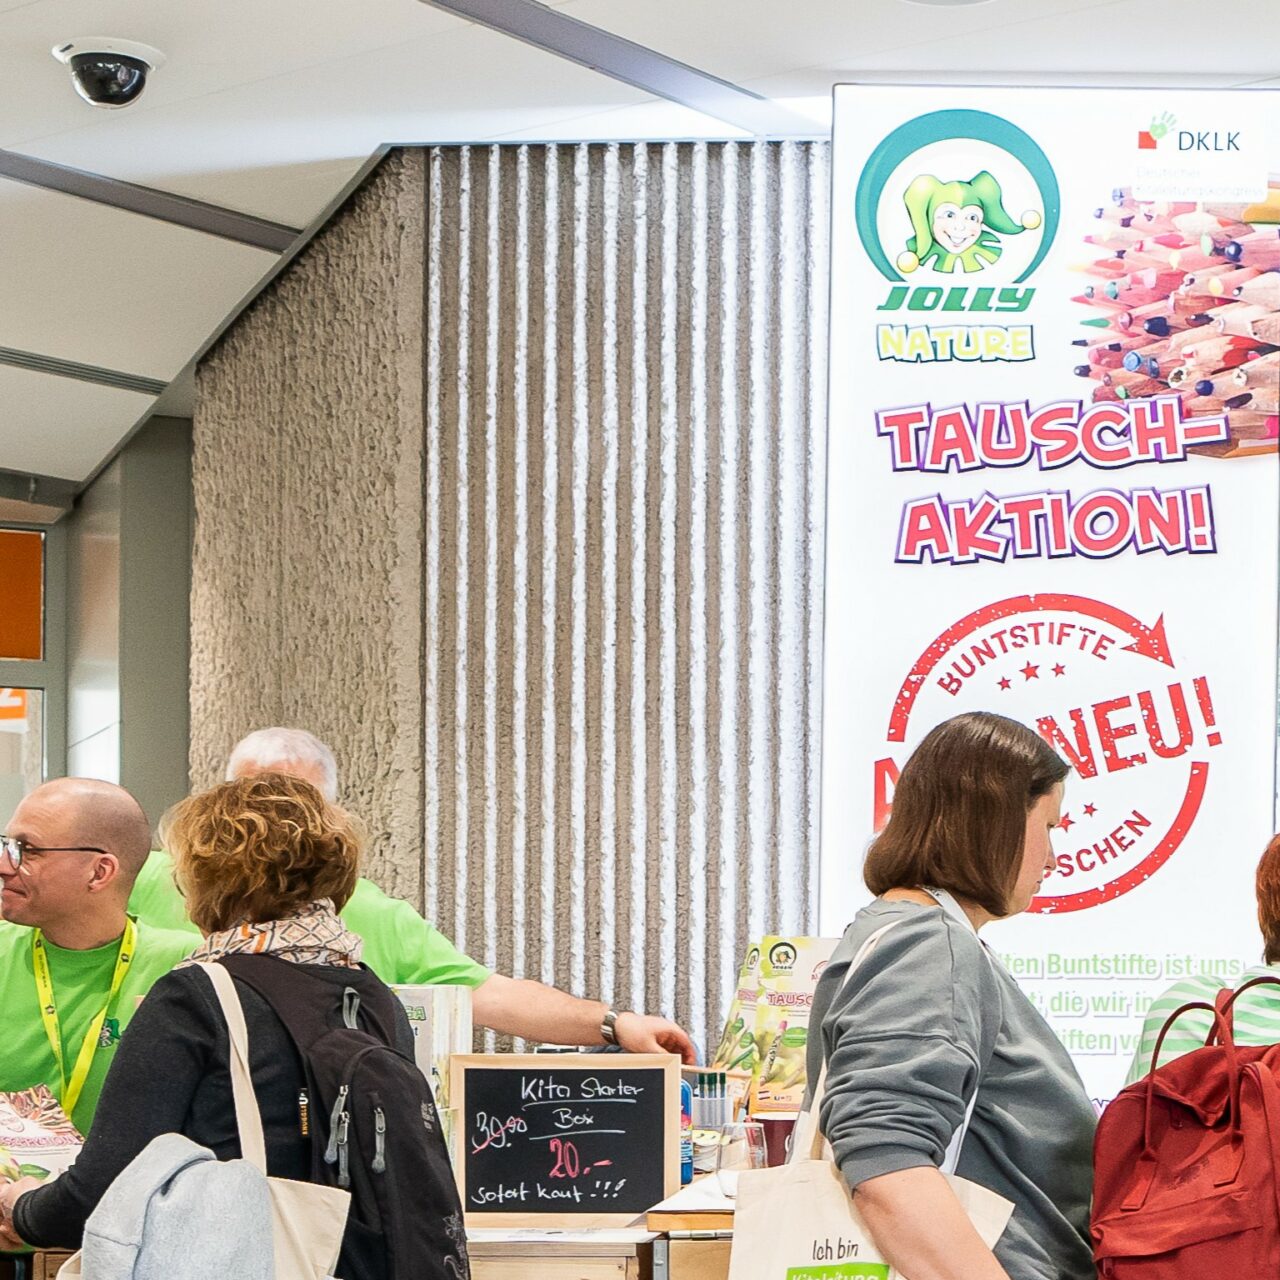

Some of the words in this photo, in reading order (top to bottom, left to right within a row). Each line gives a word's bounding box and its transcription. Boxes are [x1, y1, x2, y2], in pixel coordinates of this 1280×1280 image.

[1179, 131, 1240, 151] DKLK
[876, 286, 1036, 311] JOLLY
[877, 324, 1035, 363] NATURE
[876, 395, 1231, 474] TAUSCH-
[896, 483, 1217, 565] AKTION!
[936, 621, 1116, 697] BUNTSTIFTE
[1032, 675, 1222, 780] NEU!
[1043, 809, 1153, 880] SCHEN
[1001, 953, 1040, 975] lten
[1047, 953, 1159, 976] Buntstifte
[1165, 953, 1192, 976] ist
[1200, 959, 1240, 976] uns
[1051, 991, 1084, 1013] die
[1091, 991, 1128, 1013] wir
[521, 1076, 571, 1101] Kita
[580, 1077, 644, 1099] Starter
[552, 1108, 595, 1129] Box
[812, 1239, 833, 1262] Ich
[837, 1237, 860, 1259] bin
